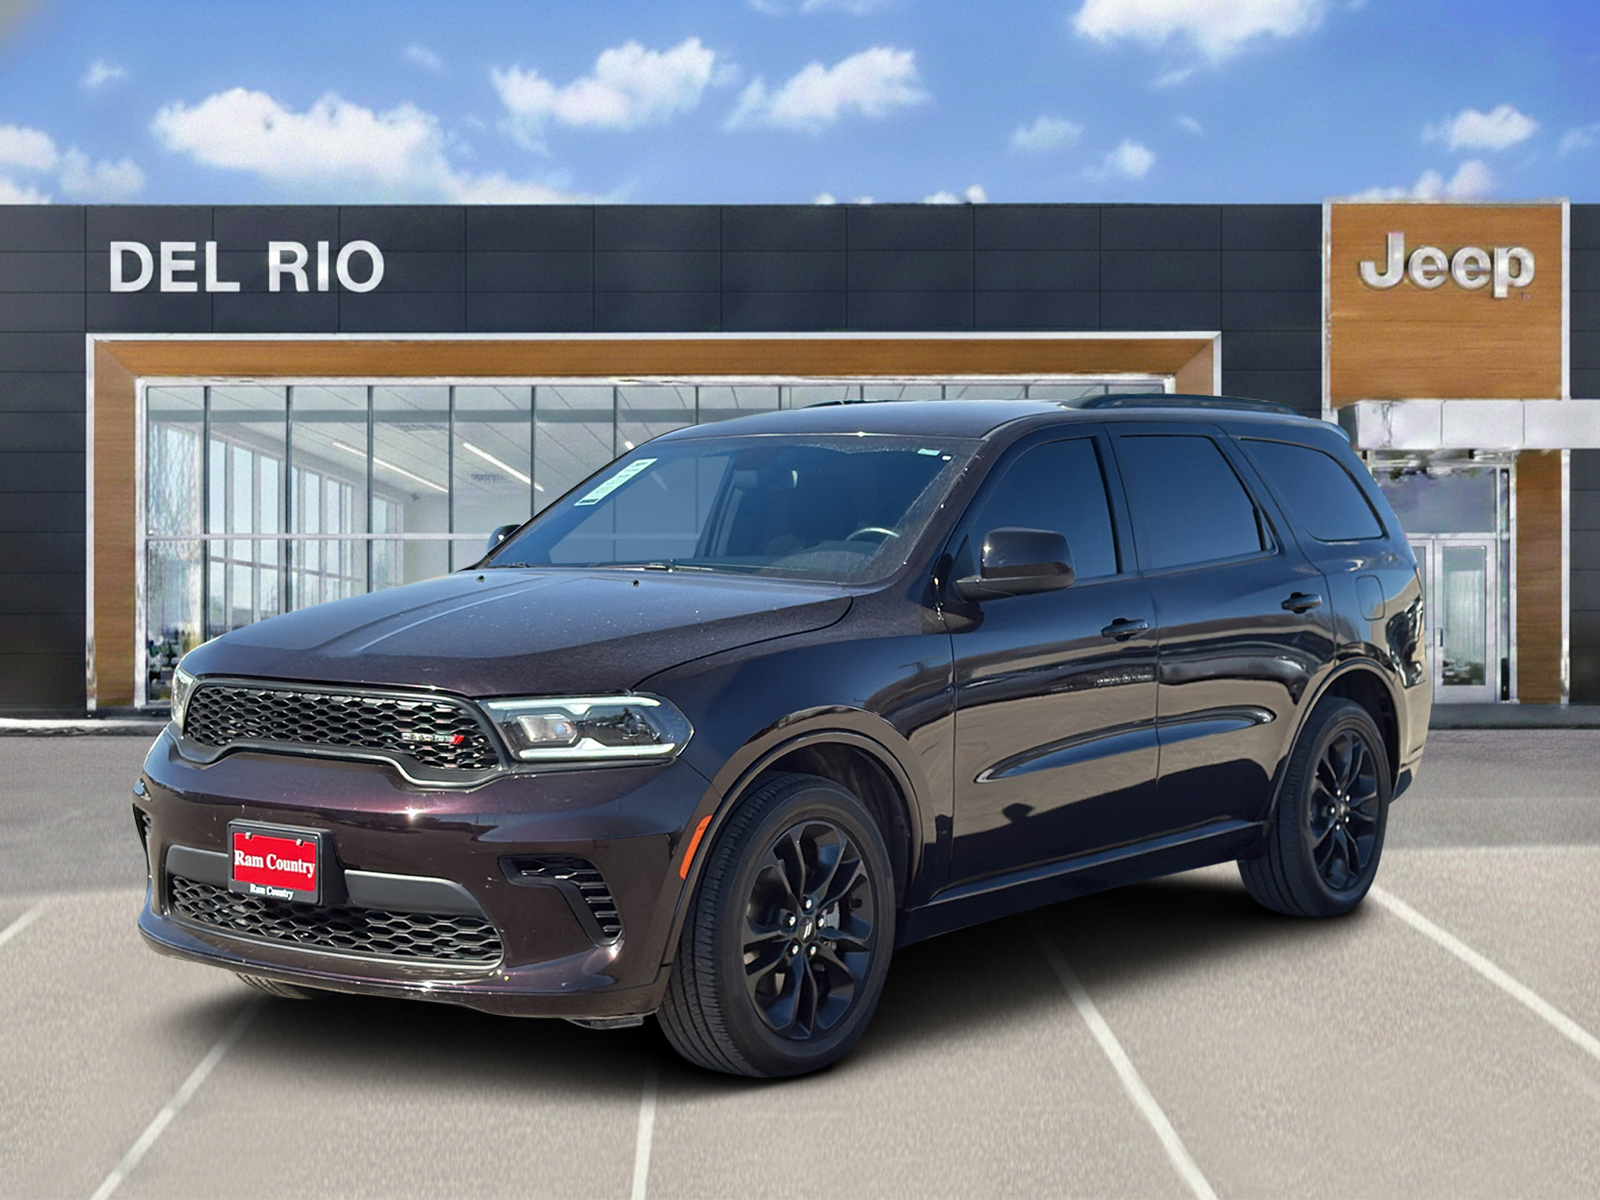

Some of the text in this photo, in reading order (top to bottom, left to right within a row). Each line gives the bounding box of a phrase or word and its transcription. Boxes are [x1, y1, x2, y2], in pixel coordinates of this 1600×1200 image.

[110, 240, 384, 292] DEL RIO
[1359, 231, 1535, 298] Jeep
[234, 850, 315, 878] Ram Country
[249, 883, 294, 900] Ram Country
